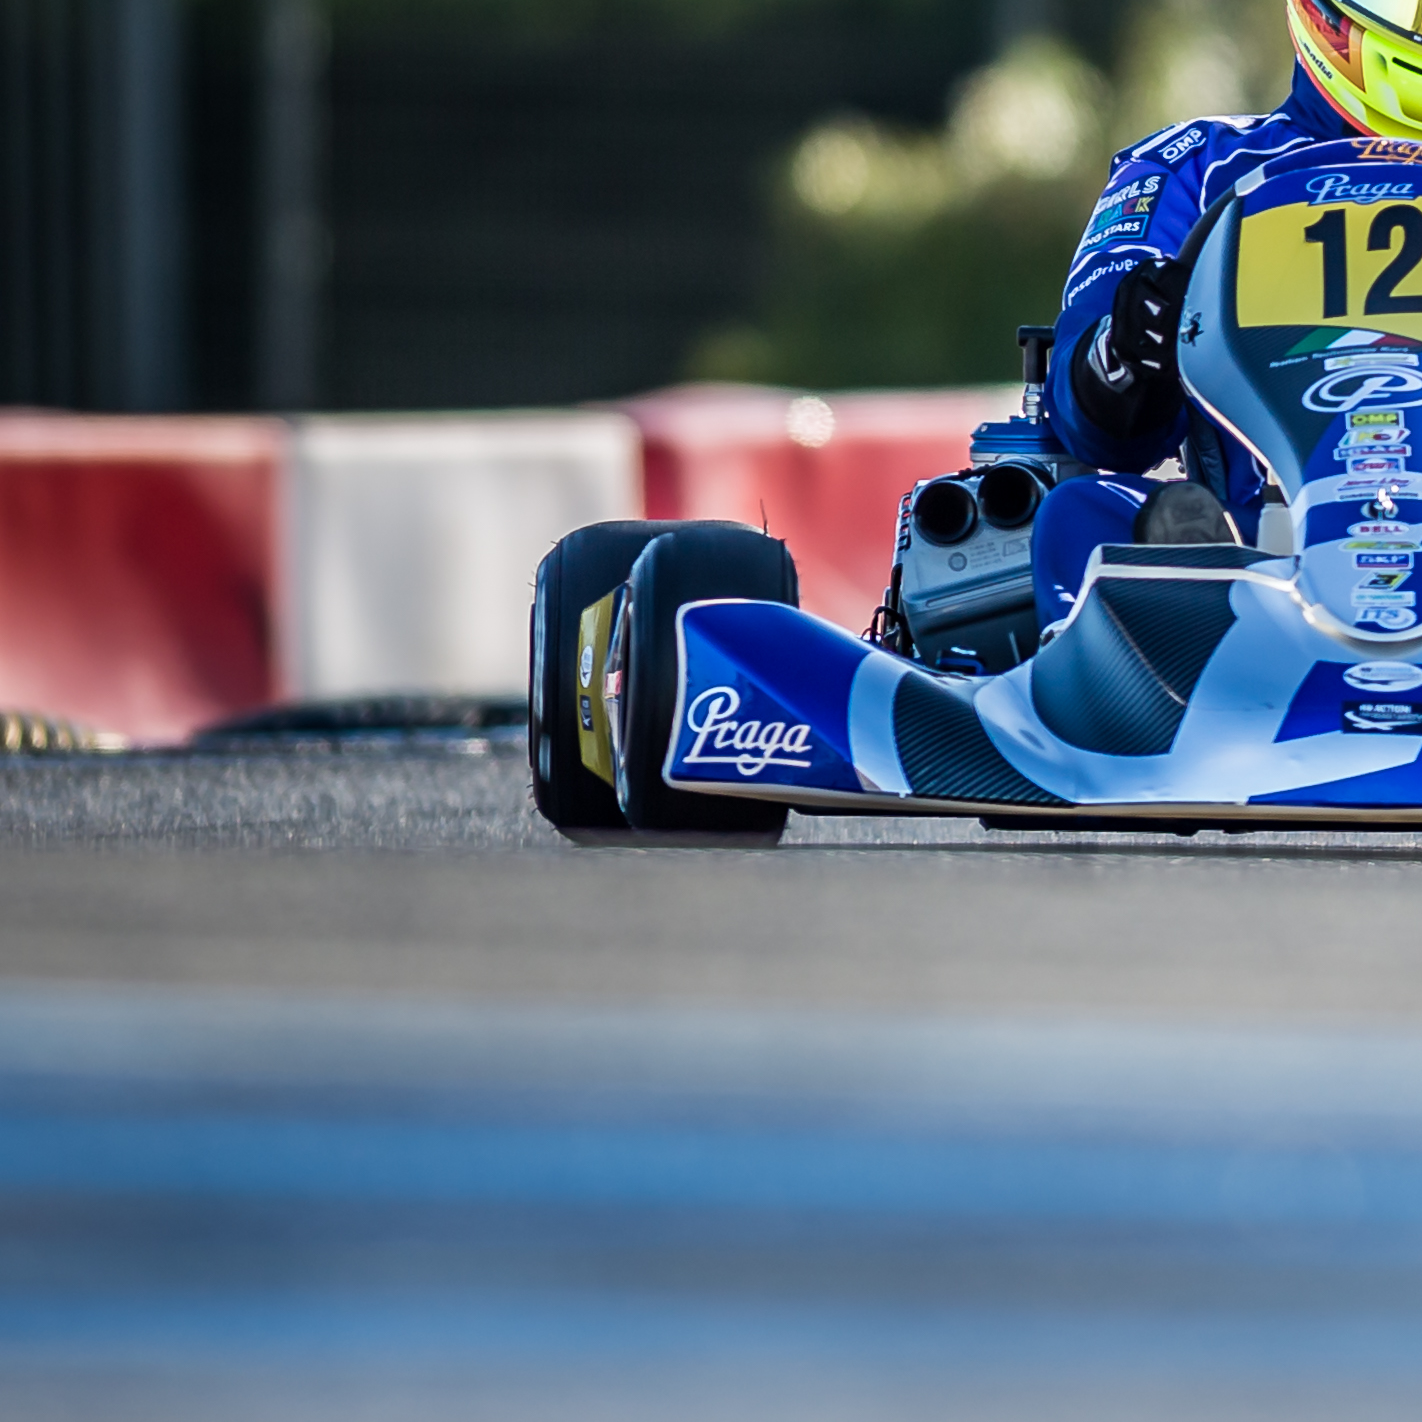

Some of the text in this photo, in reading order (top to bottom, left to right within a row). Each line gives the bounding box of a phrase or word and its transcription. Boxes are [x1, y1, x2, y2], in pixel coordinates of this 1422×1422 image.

[1162, 129, 1202, 160] OMP
[1306, 173, 1415, 205] Praga
[1103, 221, 1141, 238] STARS
[1352, 413, 1398, 427] OMP
[1360, 525, 1402, 533] BELL
[683, 686, 813, 776] Praga
